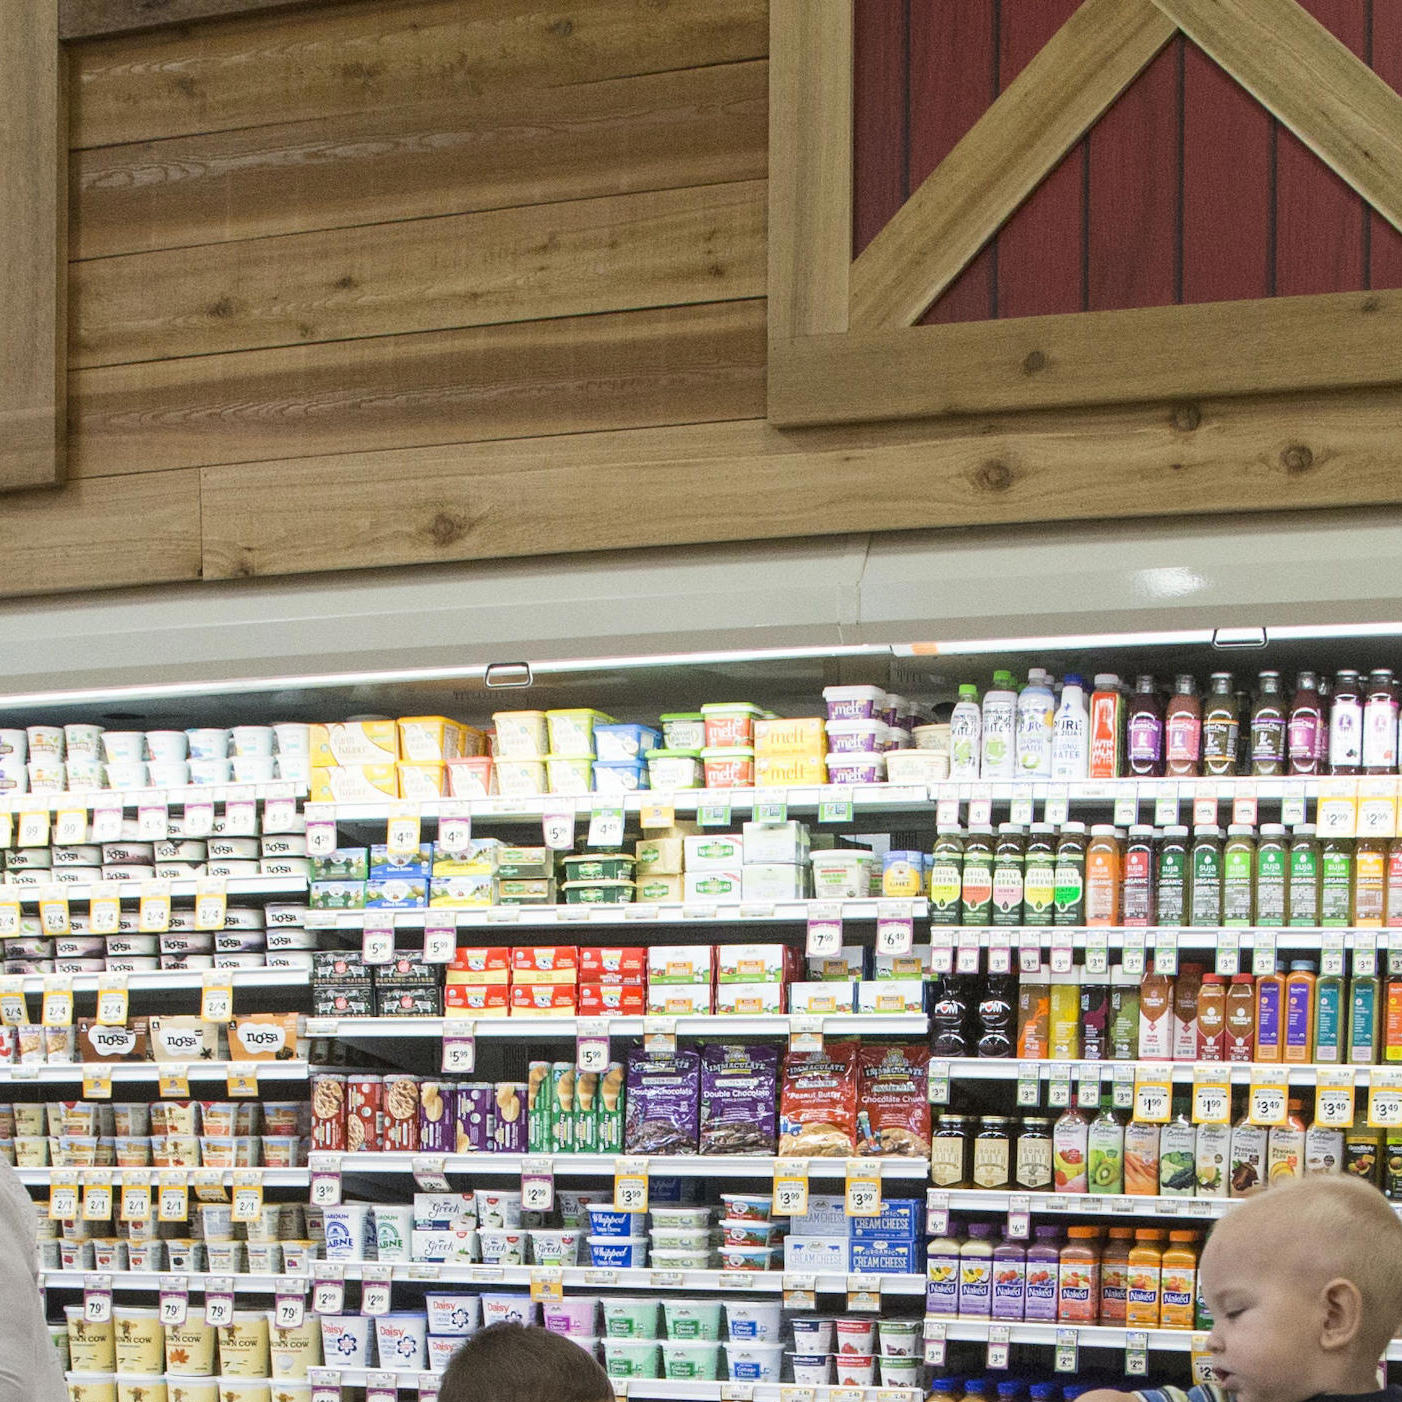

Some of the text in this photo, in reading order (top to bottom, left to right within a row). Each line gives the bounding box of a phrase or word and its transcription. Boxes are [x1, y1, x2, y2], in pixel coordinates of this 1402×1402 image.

[835, 704, 860, 716] melt
[836, 737, 861, 749] melt
[708, 767, 736, 781] melt
[836, 770, 862, 782] melt
[271, 912, 296, 923] noosa
[270, 936, 291, 946] noosa
[98, 1033, 128, 1046] noosa
[168, 1035, 197, 1047] noosa
[247, 1031, 278, 1043] noosa
[431, 1203, 459, 1217] Greek
[855, 1218, 909, 1230] CREAM CHEESE
[426, 1240, 454, 1254] Greek
[536, 1244, 561, 1257] Greek
[853, 1257, 908, 1269] CREAM CHEESE
[930, 1283, 956, 1297] Naked
[962, 1283, 987, 1296] Naked
[996, 1286, 1021, 1298] Naked
[1029, 1287, 1053, 1299] Naked
[1061, 1287, 1088, 1300] Naked
[1130, 1290, 1157, 1303] Naked
[434, 1302, 456, 1315] Daisy
[487, 1302, 510, 1314] Daisy
[380, 1325, 404, 1337] Daisy
